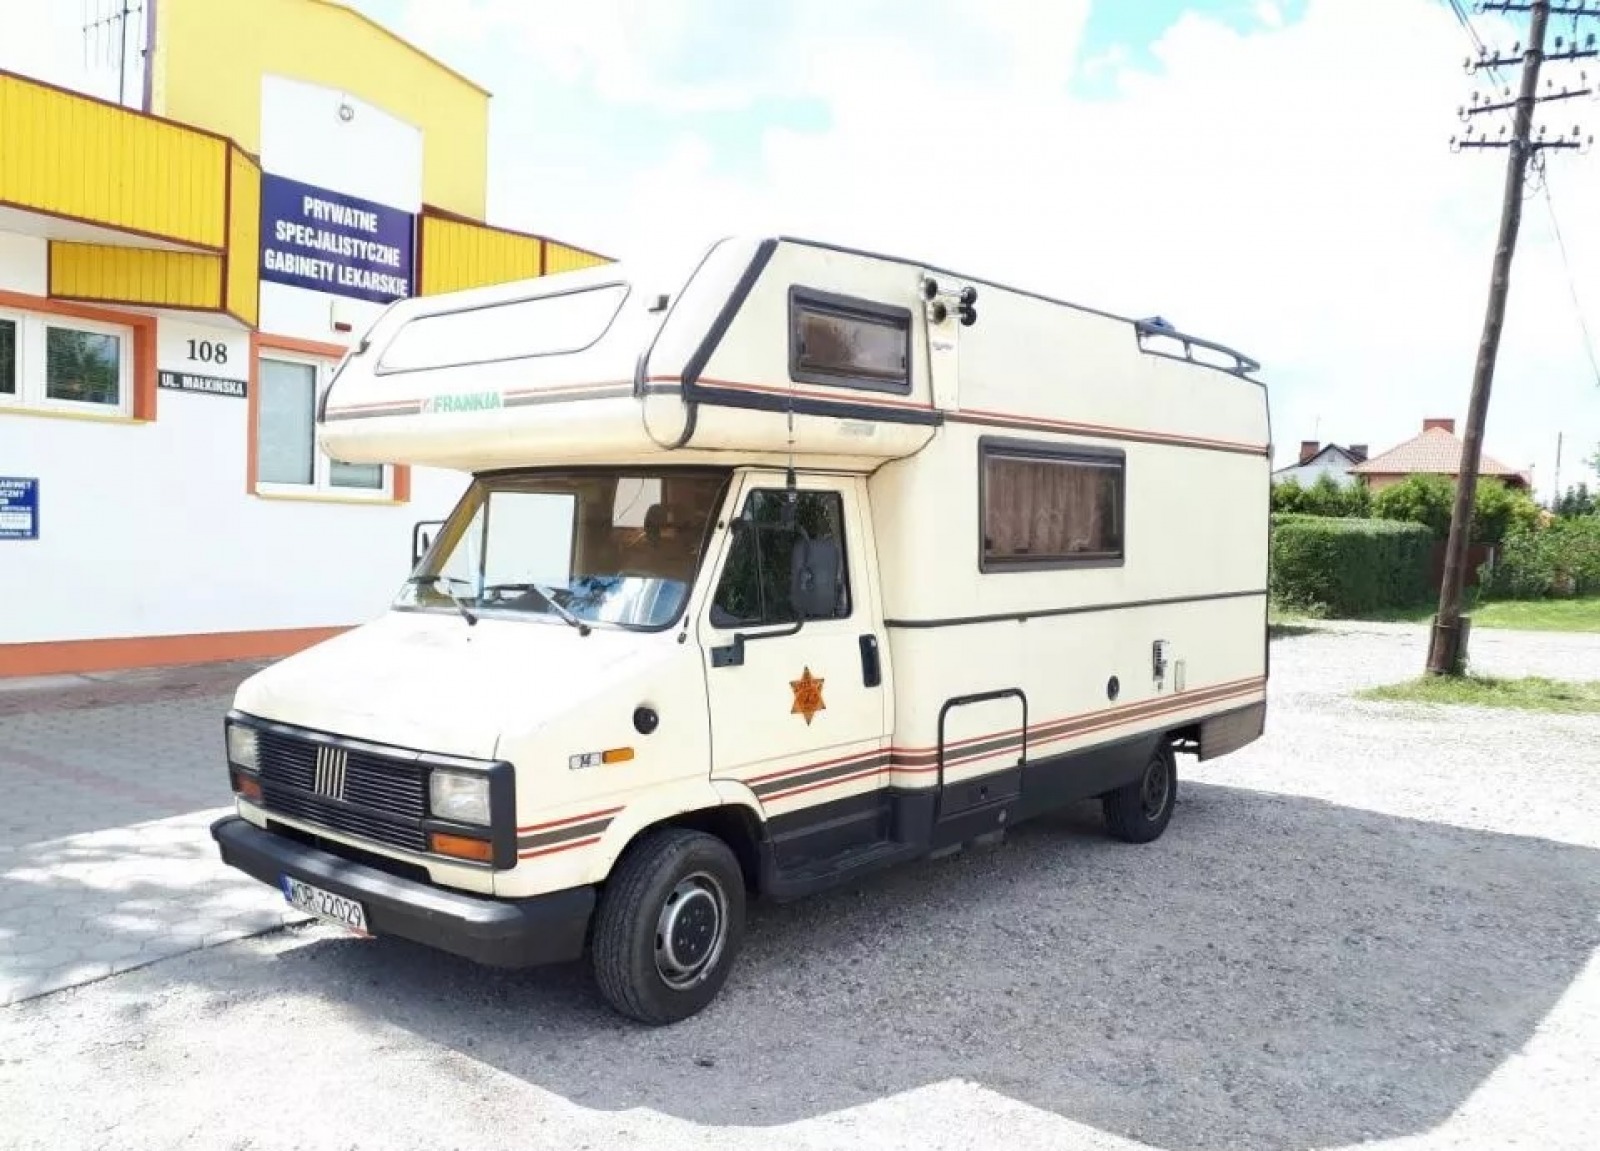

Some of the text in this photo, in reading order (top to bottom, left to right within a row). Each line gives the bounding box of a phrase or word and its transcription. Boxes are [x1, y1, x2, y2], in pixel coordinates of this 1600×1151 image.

[303, 195, 378, 233] PRYWATNE
[276, 219, 401, 268] SPECJALISTYCZNE
[264, 248, 408, 298] GABINETY LEKARSKIE
[186, 339, 228, 365] 108
[162, 373, 180, 388] UL.
[433, 391, 501, 413] FRANKIA
[318, 890, 362, 928] 22029
